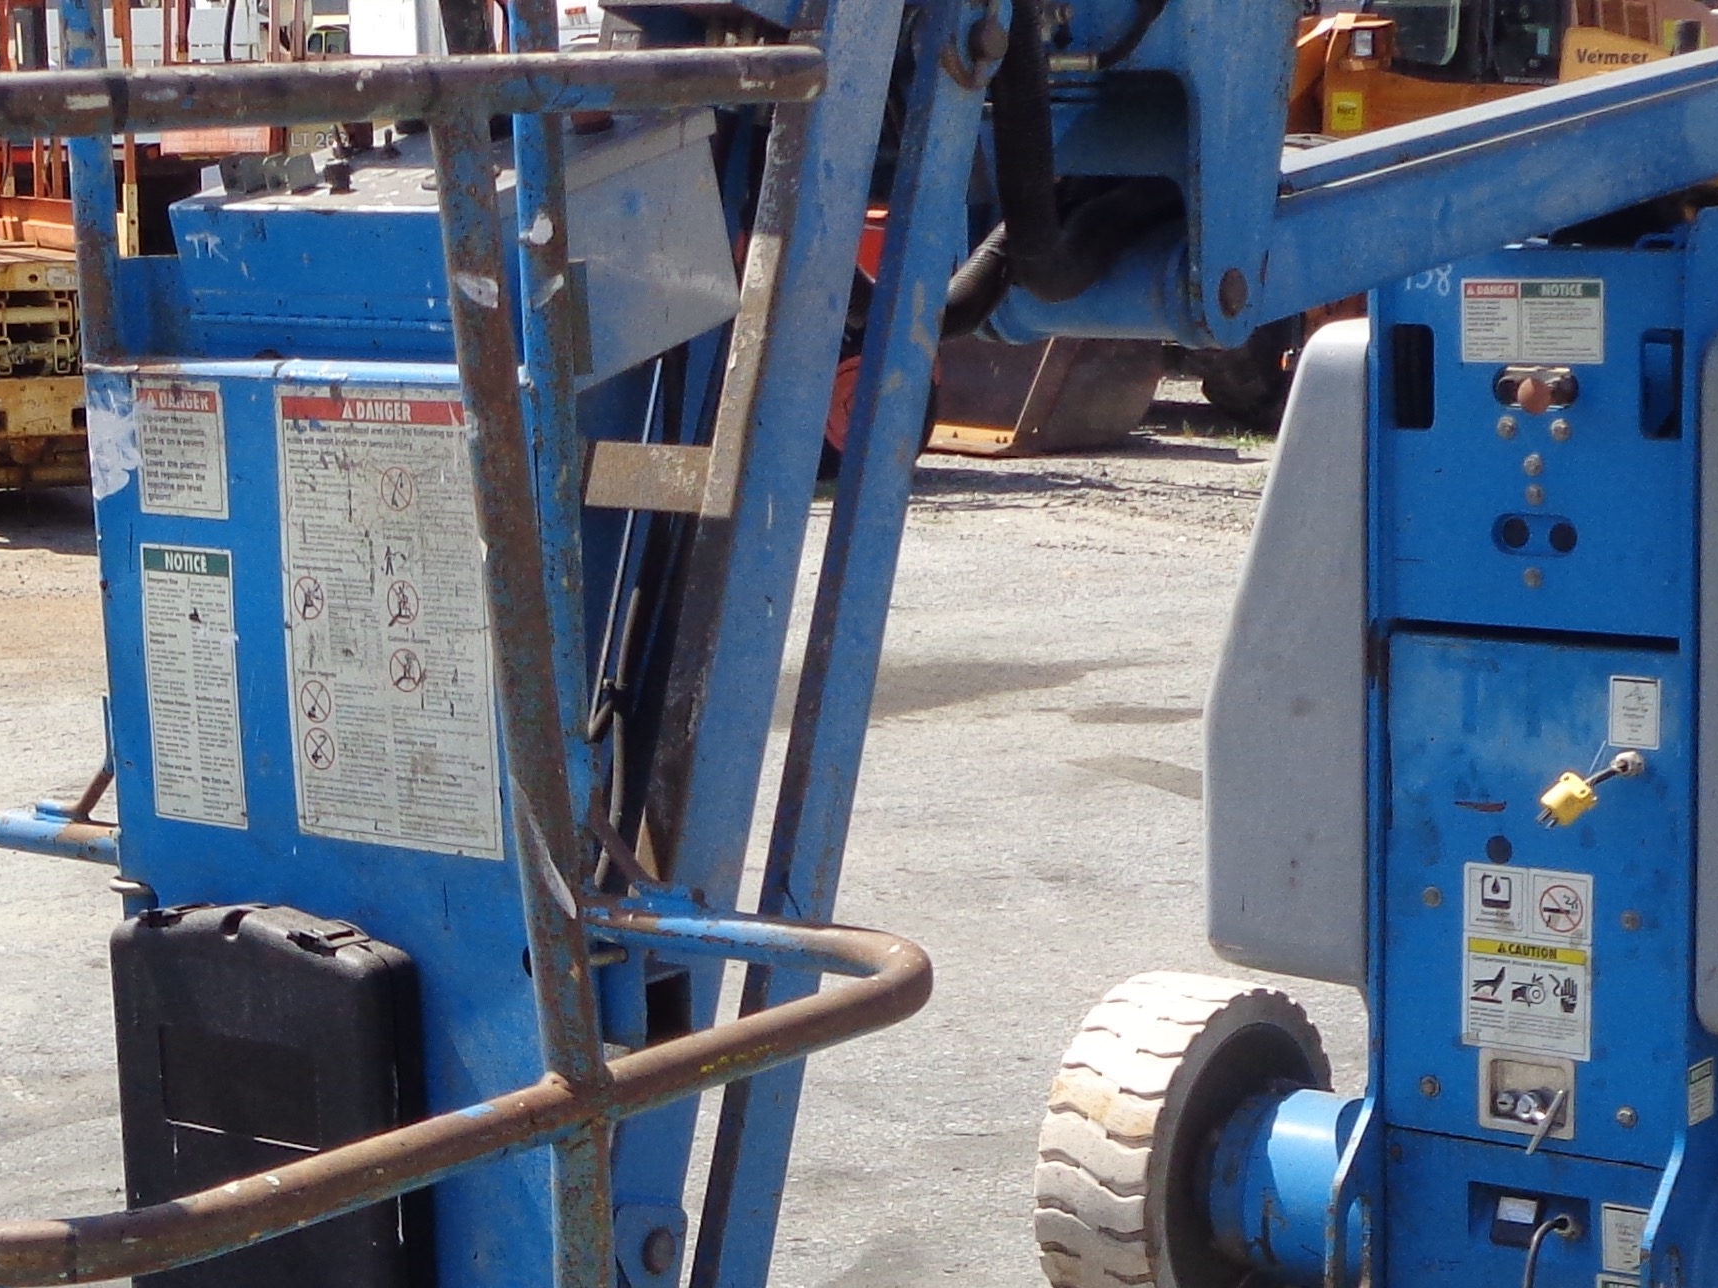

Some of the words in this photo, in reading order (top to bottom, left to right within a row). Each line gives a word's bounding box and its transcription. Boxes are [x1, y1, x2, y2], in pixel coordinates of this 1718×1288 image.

[1577, 49, 1649, 64] Vermeer
[290, 133, 310, 147] LT
[1476, 284, 1516, 296] DANGER
[1540, 283, 1583, 298] NOTICE
[356, 401, 412, 422] DANGER
[164, 551, 208, 573] NOTICE
[1509, 944, 1557, 960] CAUTION
